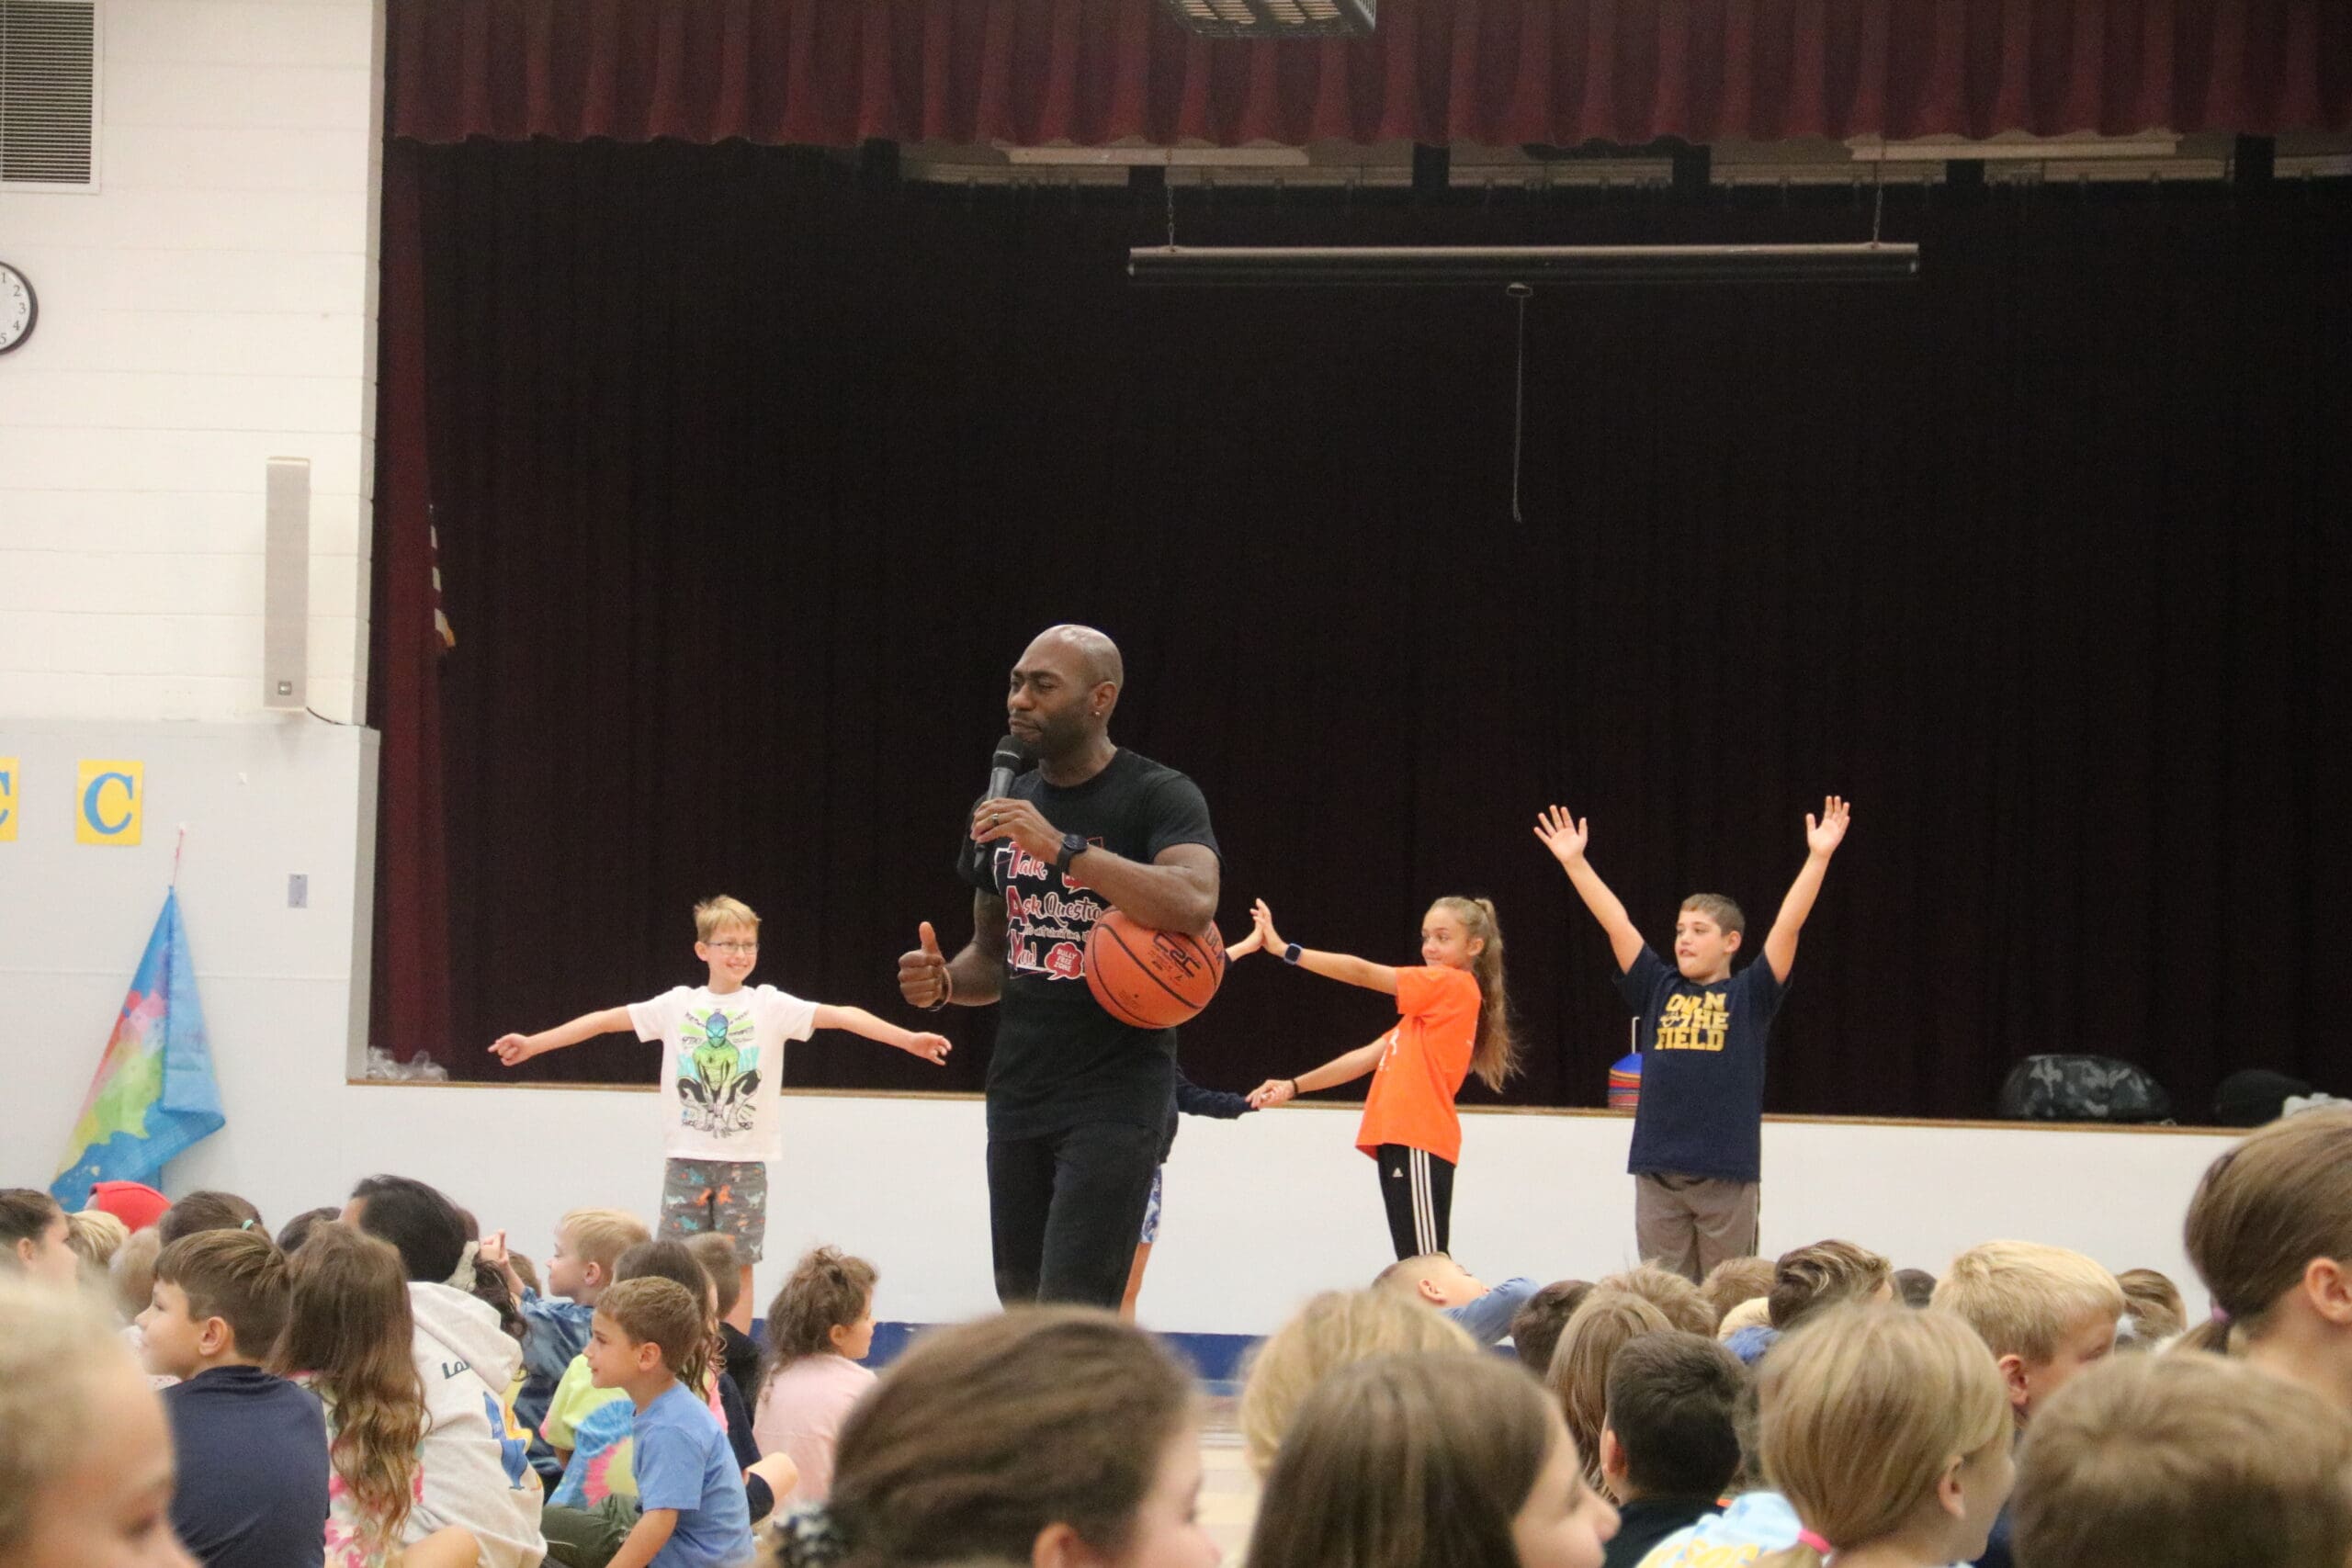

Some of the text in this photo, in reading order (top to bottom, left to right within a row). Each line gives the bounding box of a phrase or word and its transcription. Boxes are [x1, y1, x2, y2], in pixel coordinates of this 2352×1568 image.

[13, 285, 20, 297] 2
[18, 302, 26, 314] 3
[13, 320, 20, 331] 4
[0, 333, 7, 344] 5
[84, 772, 133, 835] C
[1007, 841, 1048, 880] Talk
[1006, 886, 1102, 928] Ask Questio
[1666, 991, 1726, 1013] OWN
[1655, 1027, 1724, 1052] FIELD
